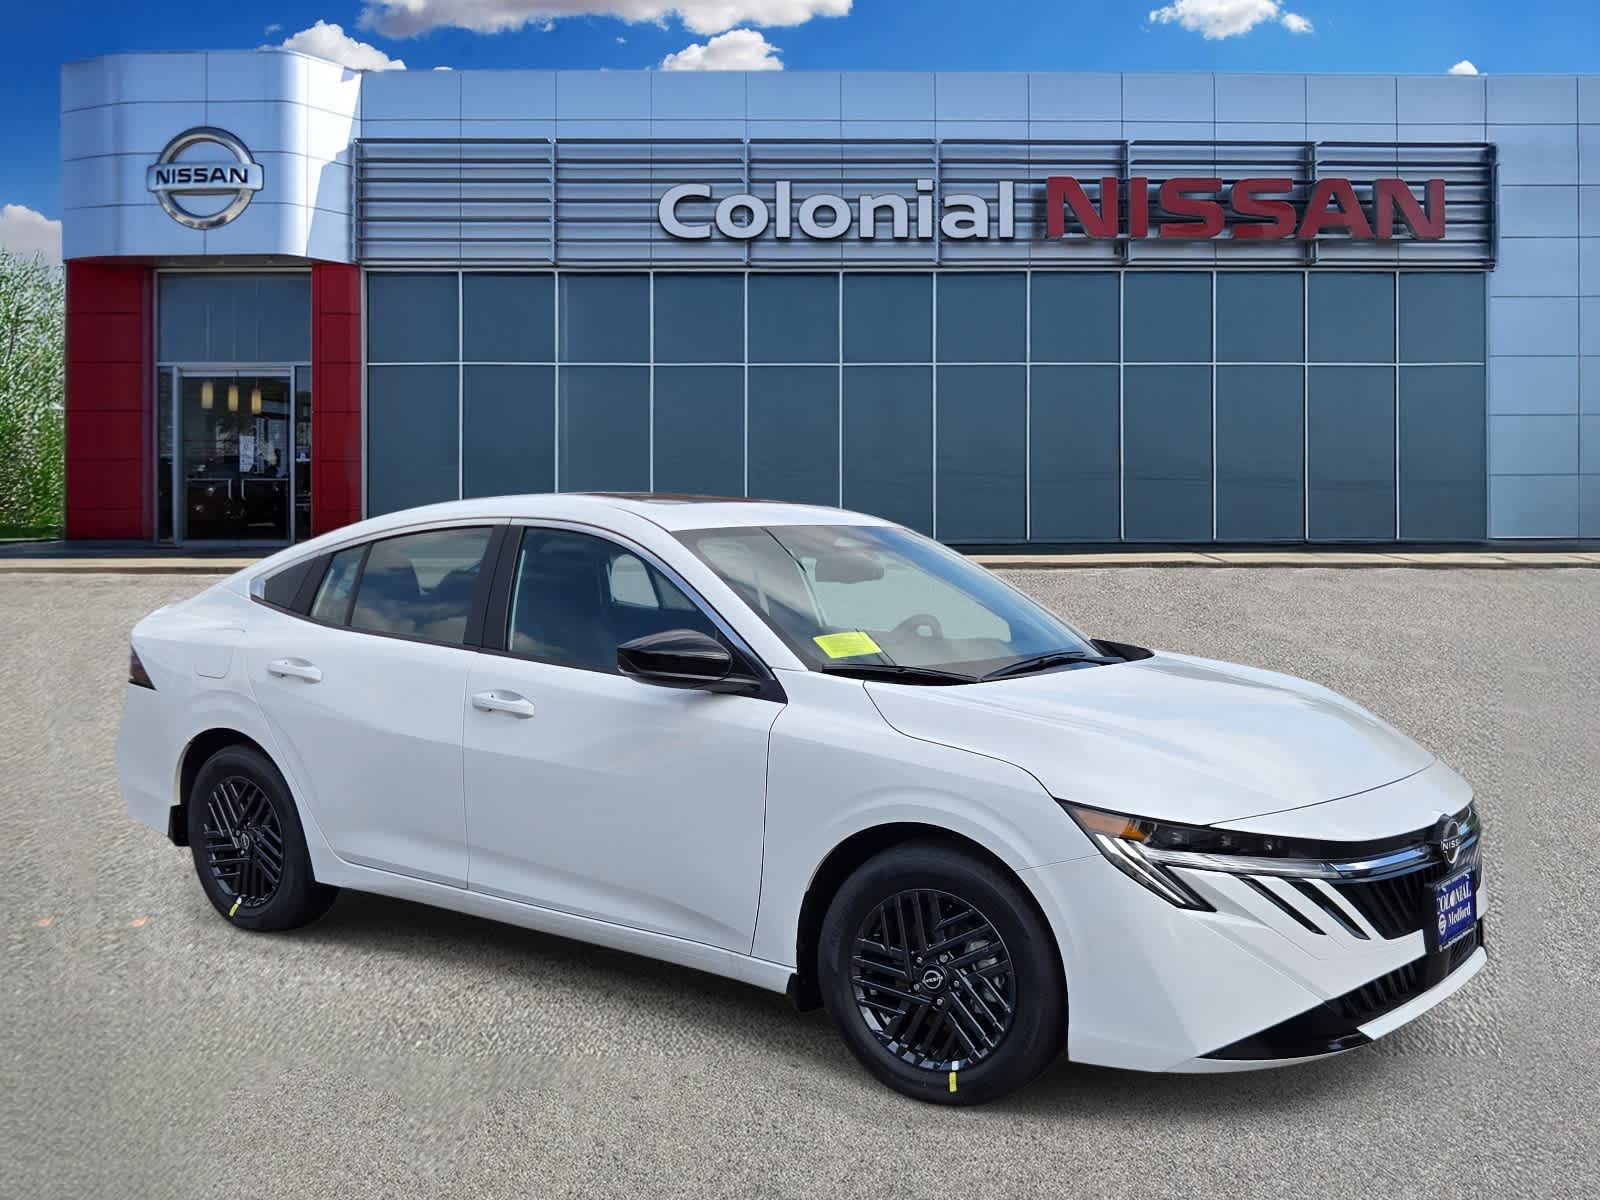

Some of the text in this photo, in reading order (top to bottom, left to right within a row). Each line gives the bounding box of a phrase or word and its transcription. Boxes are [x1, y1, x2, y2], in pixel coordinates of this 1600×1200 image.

[156, 167, 248, 185] NISSAN
[658, 175, 1446, 241] Colonial NISSAN
[1448, 901, 1471, 928] Medford
